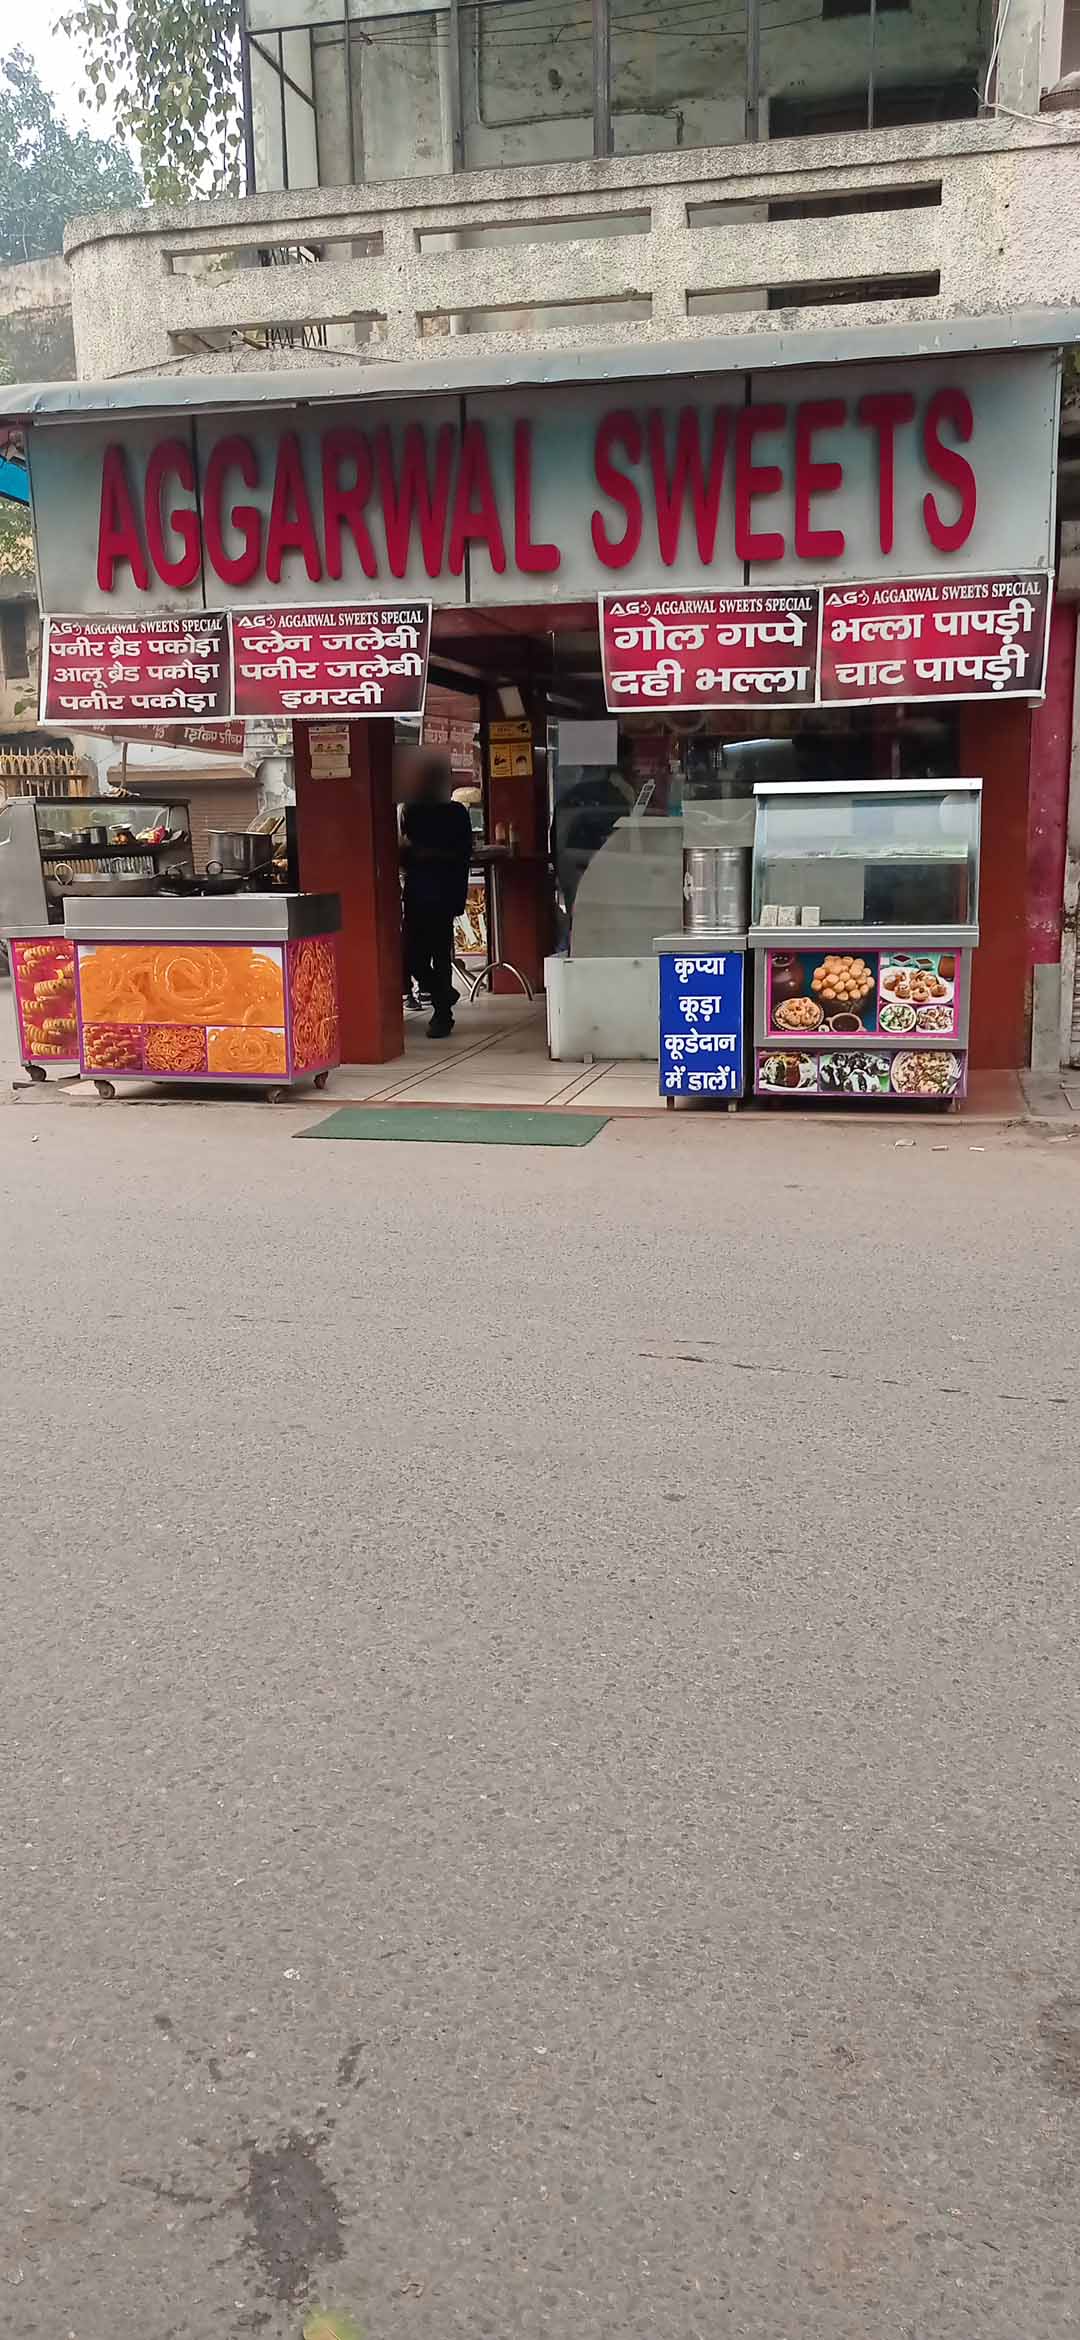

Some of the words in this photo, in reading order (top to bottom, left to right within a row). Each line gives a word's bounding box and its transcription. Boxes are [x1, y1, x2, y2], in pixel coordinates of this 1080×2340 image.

[97, 418, 561, 592] AGGARWAL
[591, 386, 977, 570] SWEETS
[653, 599, 717, 616] AGGARWAL
[719, 598, 763, 614] SWEETS
[764, 597, 812, 612] SPECIAL
[872, 586, 940, 605] AGGARWAL
[942, 584, 989, 601] SWEETS
[991, 582, 1041, 598] SPECIAL
[84, 622, 139, 635] AGGARWAL
[140, 620, 180, 633] SWEETS
[181, 618, 222, 632] SPECIAL
[278, 614, 336, 628] AGGARWAL
[338, 612, 378, 626] SWEETS
[380, 610, 424, 625] SPECIAL
[613, 616, 709, 651] गोल
[716, 612, 808, 648] गप्पे
[830, 614, 925, 642] भल्ला
[932, 597, 1036, 644] पापड़ी
[50, 636, 105, 657] पनीर
[108, 636, 142, 658] ब्रैड
[147, 633, 220, 658] पकौड़ा
[241, 630, 312, 654] प्लेन
[320, 625, 420, 651] जलेबी
[54, 667, 108, 689] आलू
[108, 661, 141, 684] ब्रैड
[146, 659, 220, 684] पकौड़ा
[240, 656, 320, 680] पनीर
[324, 652, 424, 678] जलेबी
[609, 658, 685, 697] दही
[695, 666, 810, 692] भल्ला
[834, 658, 906, 686] चाट
[913, 643, 1030, 691] पापड़ी
[58, 690, 125, 711] पनीर
[130, 688, 217, 713] पकौड़ा
[279, 681, 384, 709] इमरती
[674, 957, 726, 984] कृप्या
[678, 996, 722, 1022] कूड़ा
[664, 1028, 736, 1060] कूडेदान
[664, 1065, 686, 1089] में
